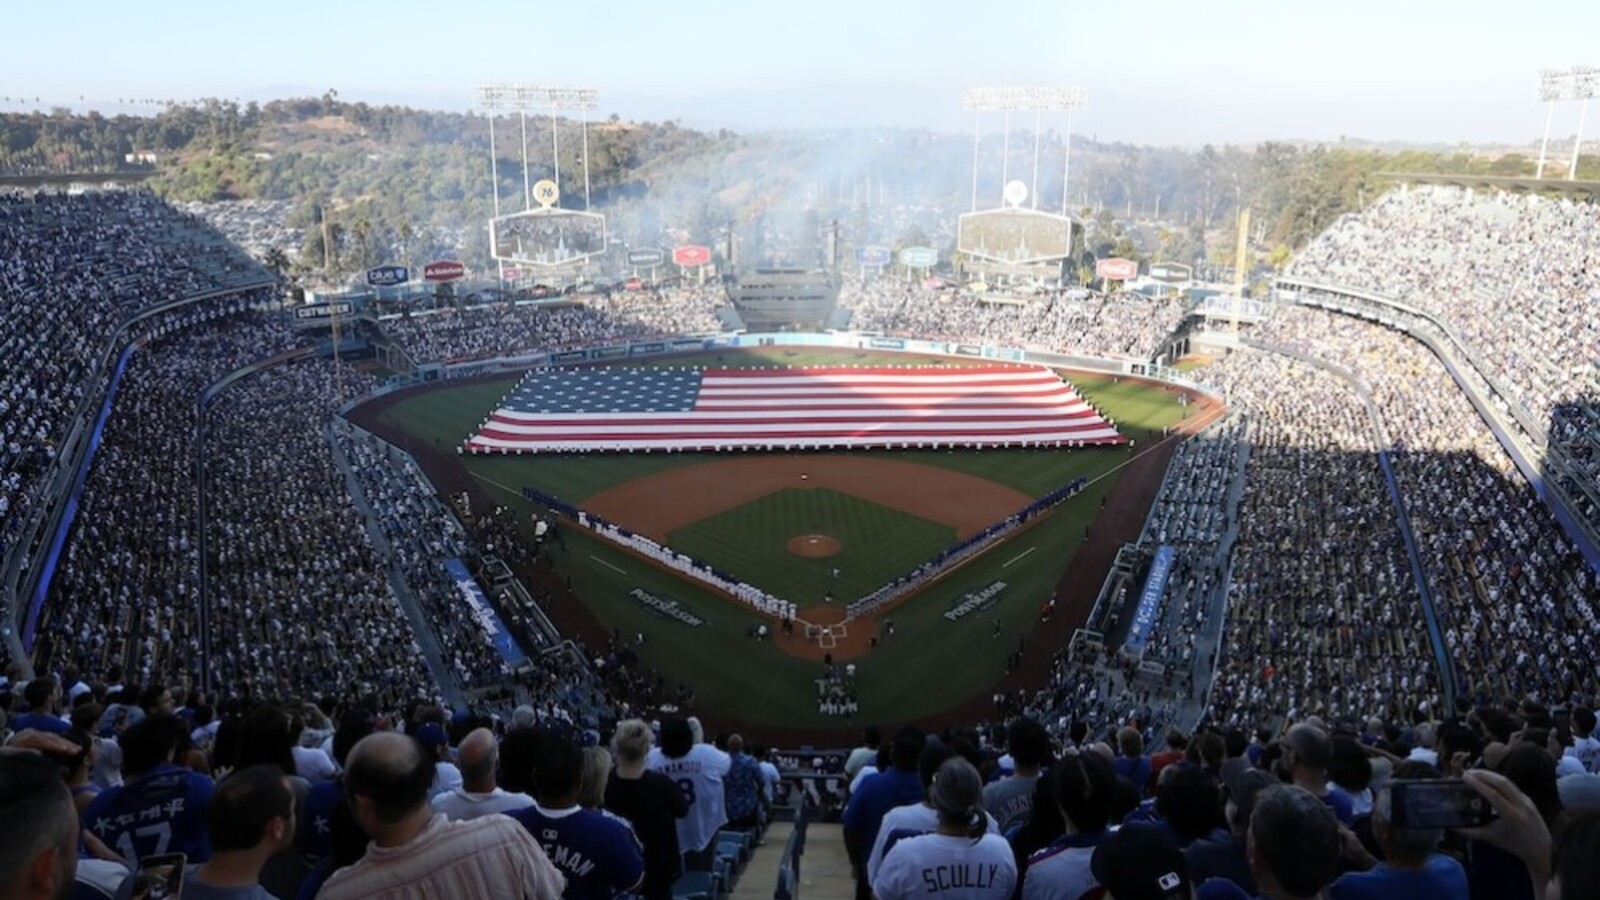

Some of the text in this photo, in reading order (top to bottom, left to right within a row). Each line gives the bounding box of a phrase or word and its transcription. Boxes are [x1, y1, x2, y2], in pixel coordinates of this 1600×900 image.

[540, 187, 553, 198] 76
[116, 820, 172, 874] 17
[543, 843, 595, 877] EMAN
[922, 864, 998, 893] SCULLY
